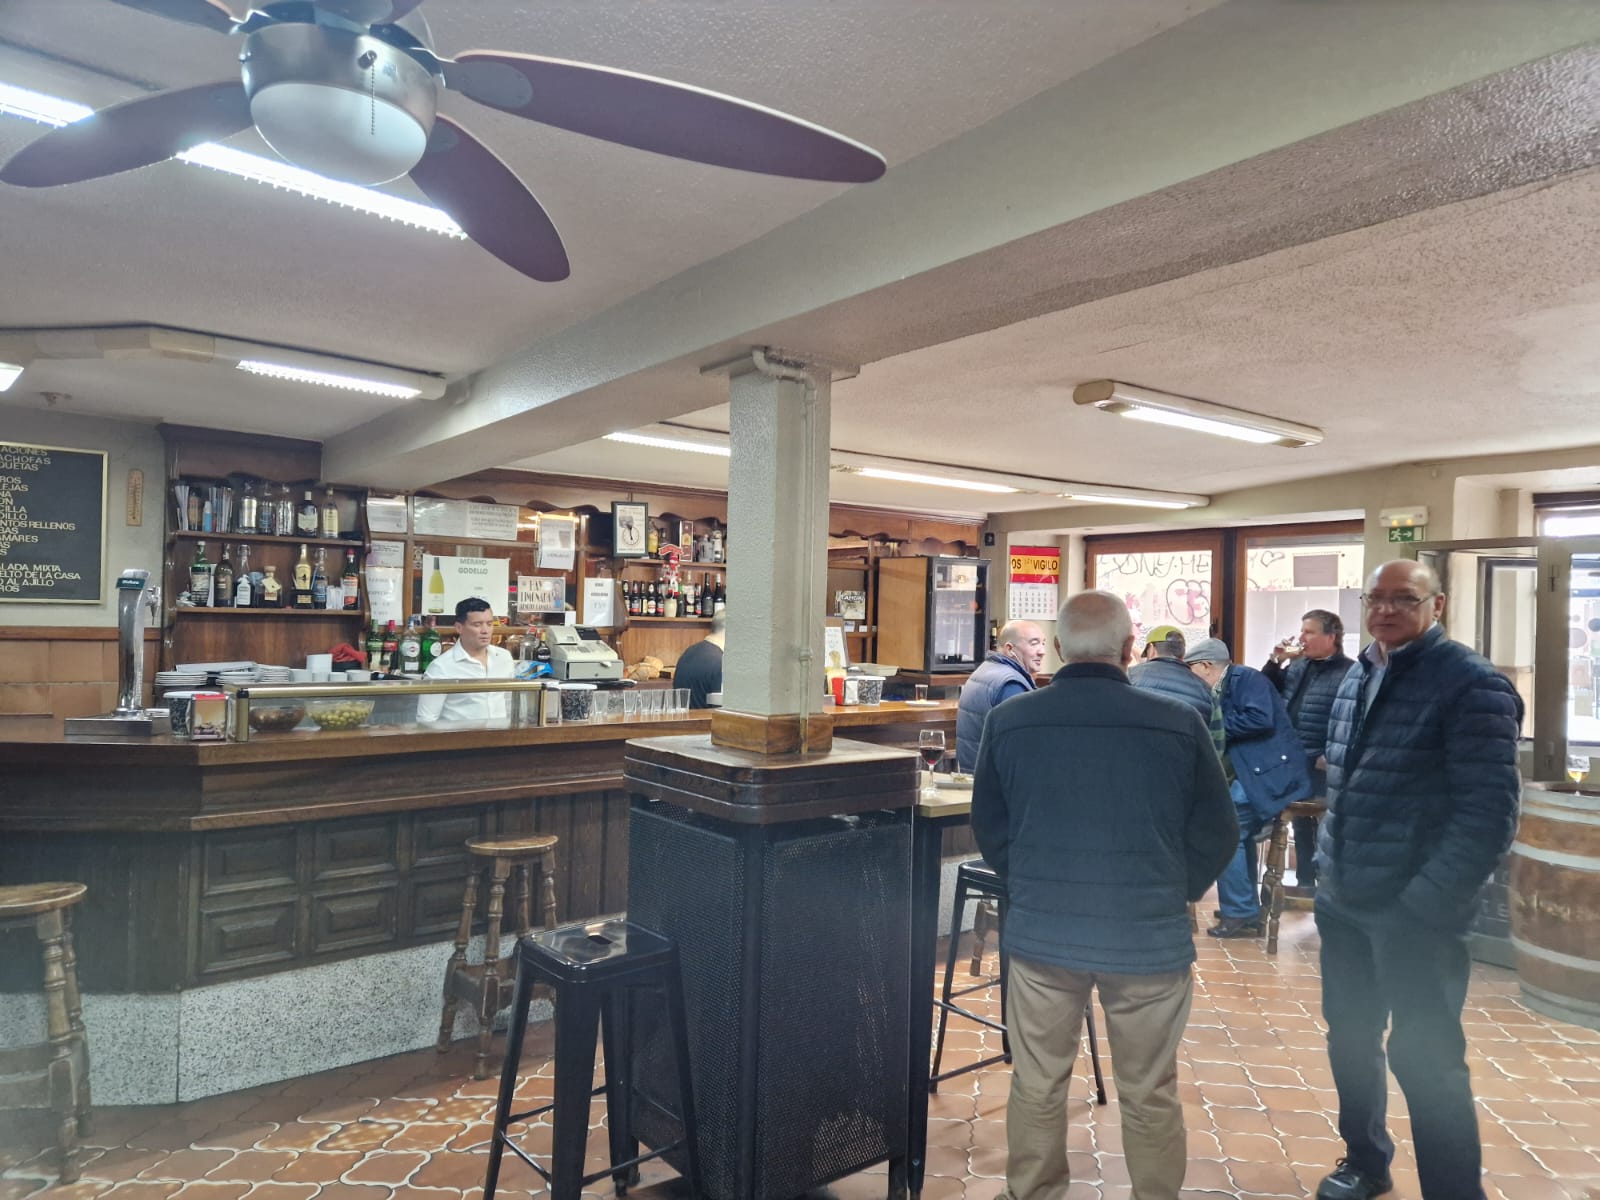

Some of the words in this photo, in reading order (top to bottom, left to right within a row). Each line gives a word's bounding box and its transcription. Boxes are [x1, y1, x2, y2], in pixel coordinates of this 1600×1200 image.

[29, 521, 76, 531] RELLENOS
[0, 534, 39, 543] MARES
[33, 564, 61, 572] MIXTA
[1033, 559, 1058, 570] VIGILO
[24, 571, 38, 579] DE
[39, 571, 53, 579] LA
[54, 572, 81, 580] CASA
[458, 567, 489, 575] GODELLO
[22, 579, 55, 587] AJILLO
